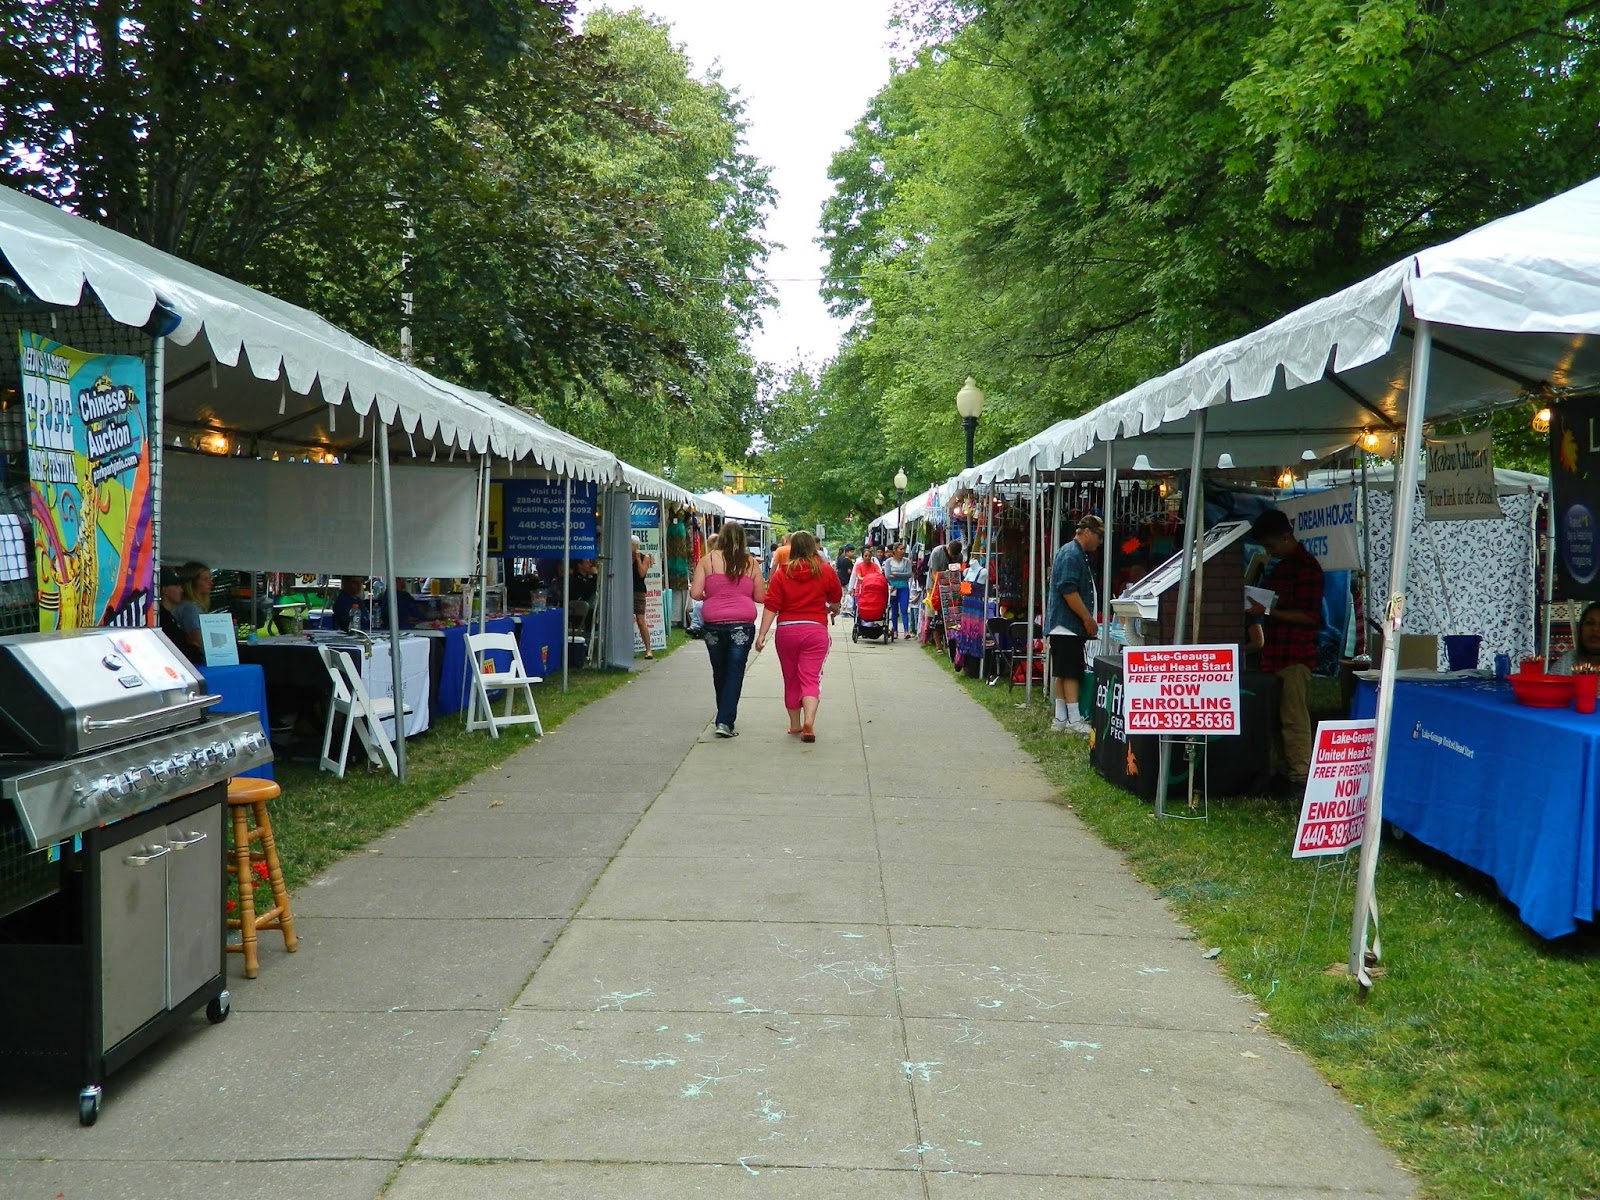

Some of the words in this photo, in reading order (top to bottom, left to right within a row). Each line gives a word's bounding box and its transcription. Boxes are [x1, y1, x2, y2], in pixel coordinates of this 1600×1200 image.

[23, 374, 75, 450] FREE
[80, 389, 127, 422] Chinese
[88, 422, 130, 458] Auction
[1456, 441, 1488, 474] Library
[48, 452, 78, 484] FESTIVAL
[1298, 507, 1325, 531] DREAM
[1326, 503, 1354, 526] HOUSE
[1143, 652, 1216, 662] Lake-Geauga
[1130, 663, 1166, 672] United
[1170, 663, 1198, 672] Head
[1202, 662, 1231, 671] Start
[1128, 675, 1157, 683] FREE
[1160, 674, 1233, 682] PRESCHOOL!
[1160, 684, 1201, 696] NOW
[1131, 698, 1231, 710] ENROLLING
[1131, 713, 1232, 728] 440-392-5636
[1331, 731, 1374, 744] Lake-Geauga
[1318, 749, 1345, 761] United
[1348, 748, 1364, 759] Head
[1313, 766, 1337, 778] FREE
[1335, 778, 1362, 797] NOW
[1307, 796, 1367, 820] ENROLLING
